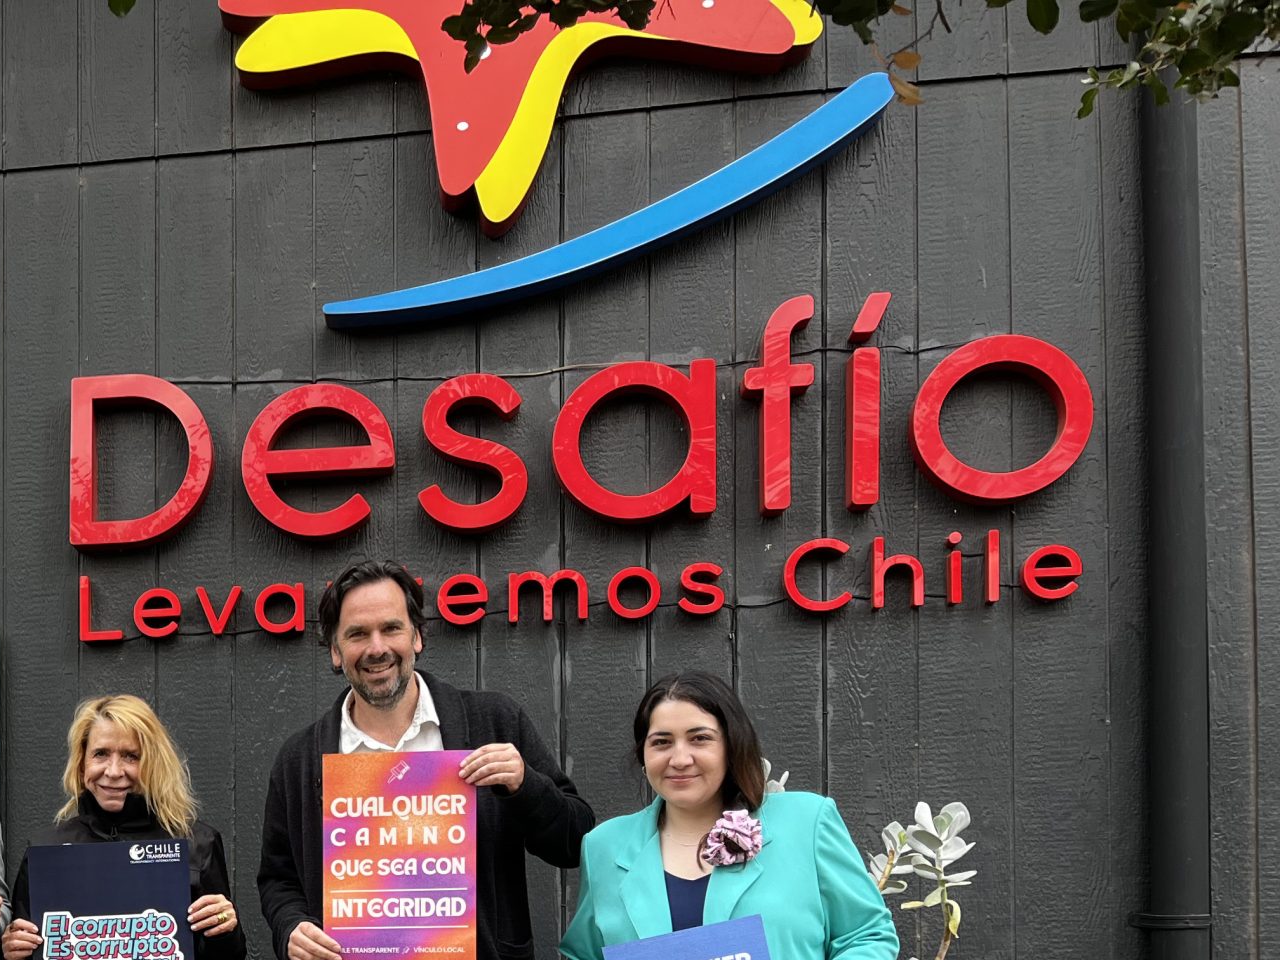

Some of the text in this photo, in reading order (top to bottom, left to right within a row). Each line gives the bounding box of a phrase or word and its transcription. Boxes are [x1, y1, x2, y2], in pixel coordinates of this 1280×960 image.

[69, 291, 1094, 550] Desafío
[79, 528, 1083, 643] Levaemos Chile
[330, 794, 467, 820] CUALQUIER
[330, 825, 466, 847] CAMINO
[145, 843, 181, 854] CHILE
[330, 857, 466, 880] QUE SEA CON
[332, 896, 467, 918] INTEGRIDAD
[45, 912, 175, 940] El corrupto
[46, 934, 177, 960] Es corrupto
[413, 945, 442, 953] VÍNCULO
